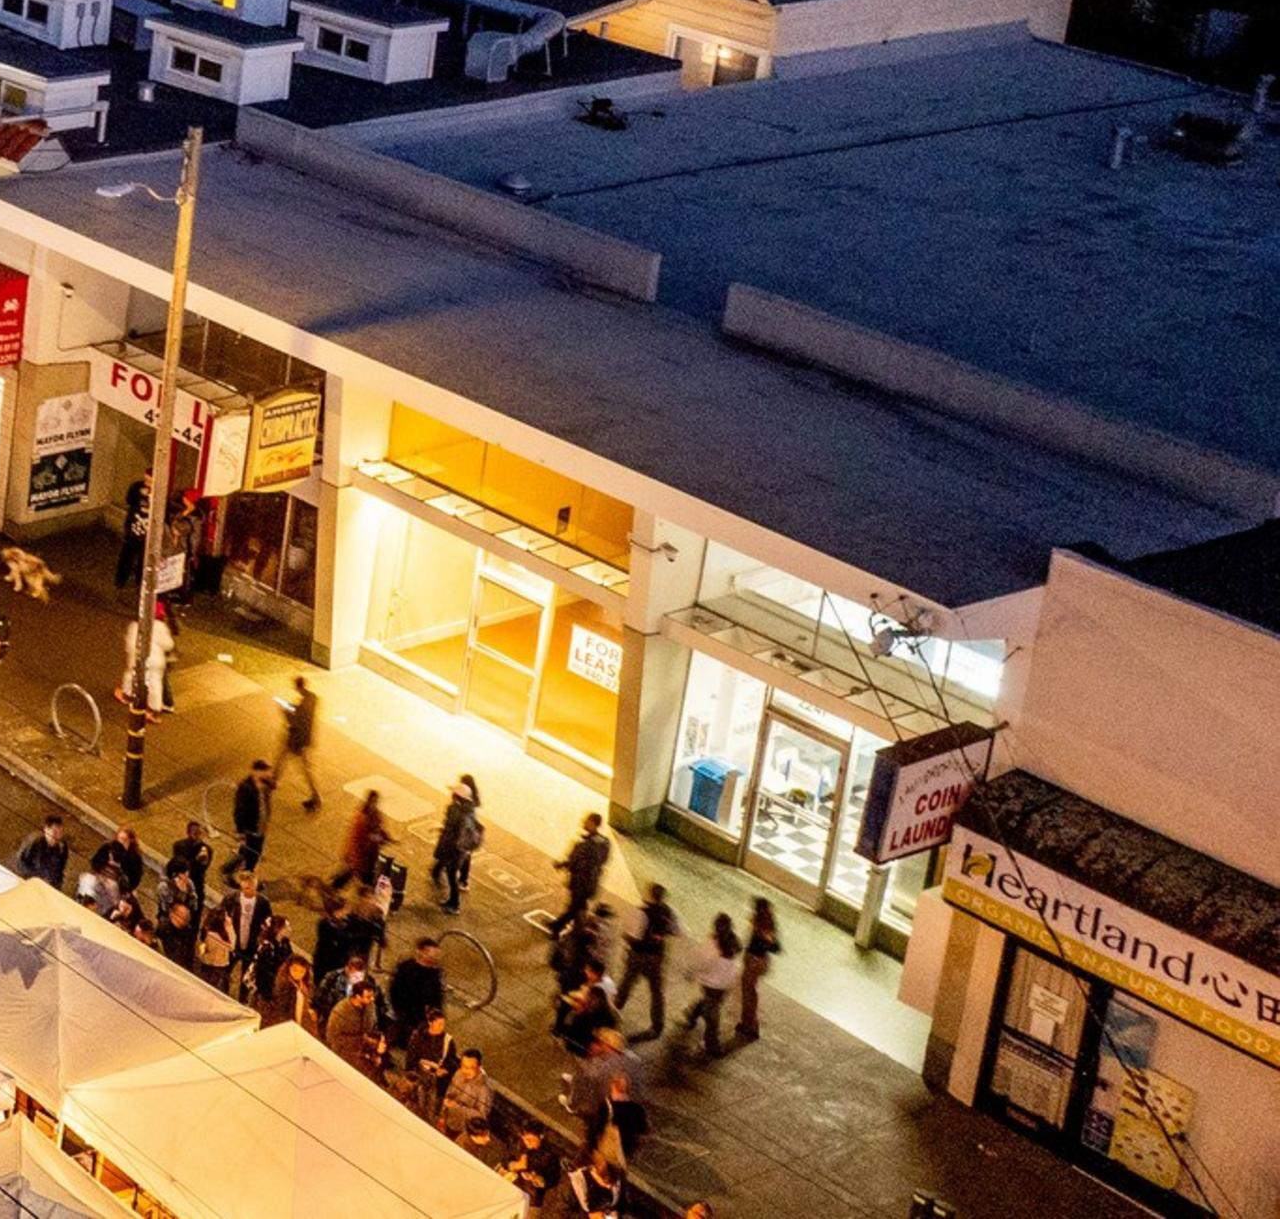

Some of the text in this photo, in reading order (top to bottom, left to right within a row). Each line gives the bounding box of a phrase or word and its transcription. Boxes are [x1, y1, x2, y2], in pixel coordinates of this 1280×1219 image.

[111, 362, 163, 409] FO
[36, 428, 91, 445] MAYOR FLYNN
[30, 483, 86, 502] MAYOR FLYNN
[575, 648, 616, 677] LEAS
[586, 636, 619, 662] FOR
[914, 783, 962, 816] COIN
[889, 815, 949, 852] LAUND
[961, 844, 1195, 986] Heartland
[955, 888, 1052, 941] ORGANIC
[1081, 951, 1189, 1019] NATURAL
